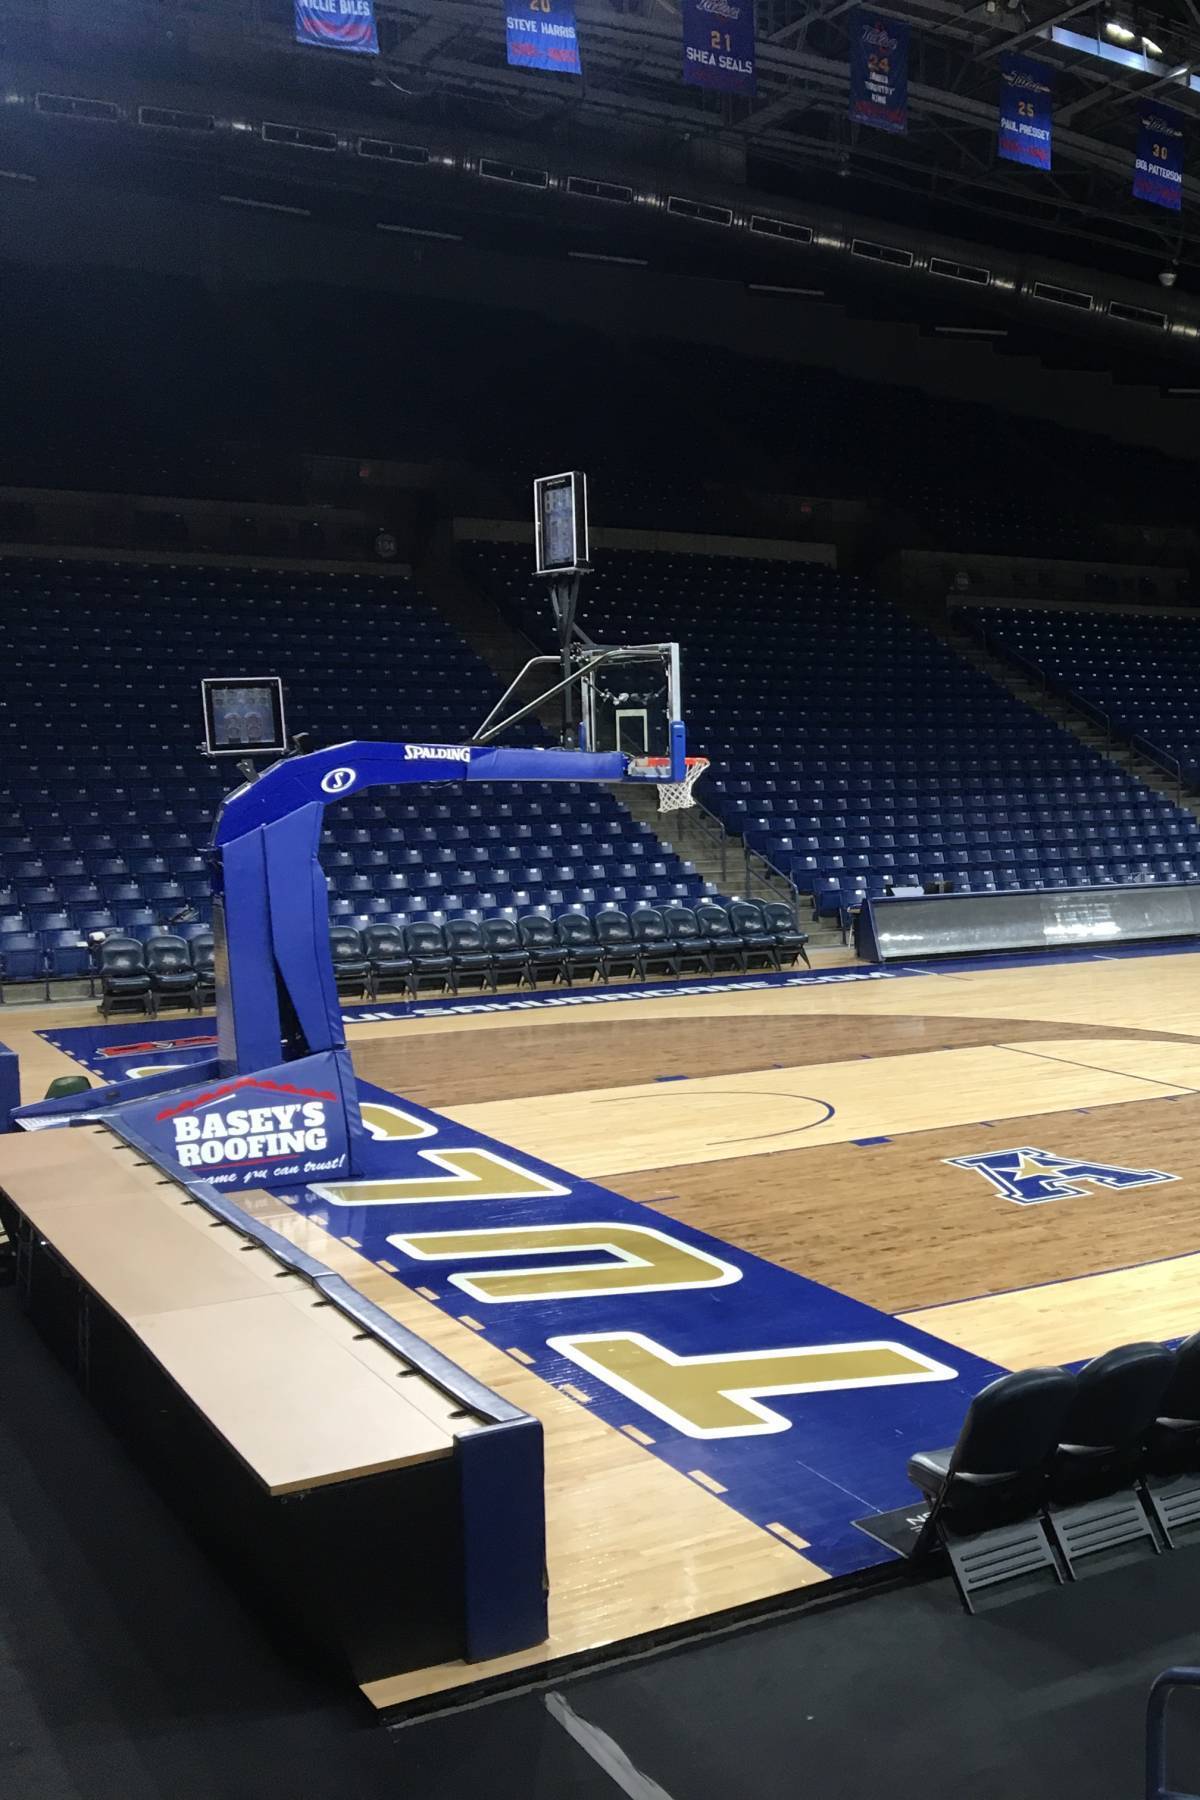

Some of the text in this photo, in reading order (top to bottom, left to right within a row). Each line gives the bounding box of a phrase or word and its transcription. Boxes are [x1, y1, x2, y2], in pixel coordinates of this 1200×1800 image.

[341, 0, 371, 16] BILES
[506, 16, 576, 39] STEVE HARRIS
[711, 30, 731, 52] 21
[686, 46, 753, 74] SHEA SEALS
[1018, 100, 1034, 118] 25
[1000, 117, 1019, 132] PAUL
[1152, 143, 1168, 160] 30
[1148, 163, 1182, 183] PATTERSON
[404, 744, 471, 763] SPALDING
[341, 971, 896, 1022] ULSAHURRICANE.COM
[172, 1101, 326, 1143] BASEY'S
[176, 1127, 328, 1167] ROOFING
[273, 1163, 300, 1177] can
[303, 1153, 347, 1174] trust!
[940, 1146, 1183, 1206] A
